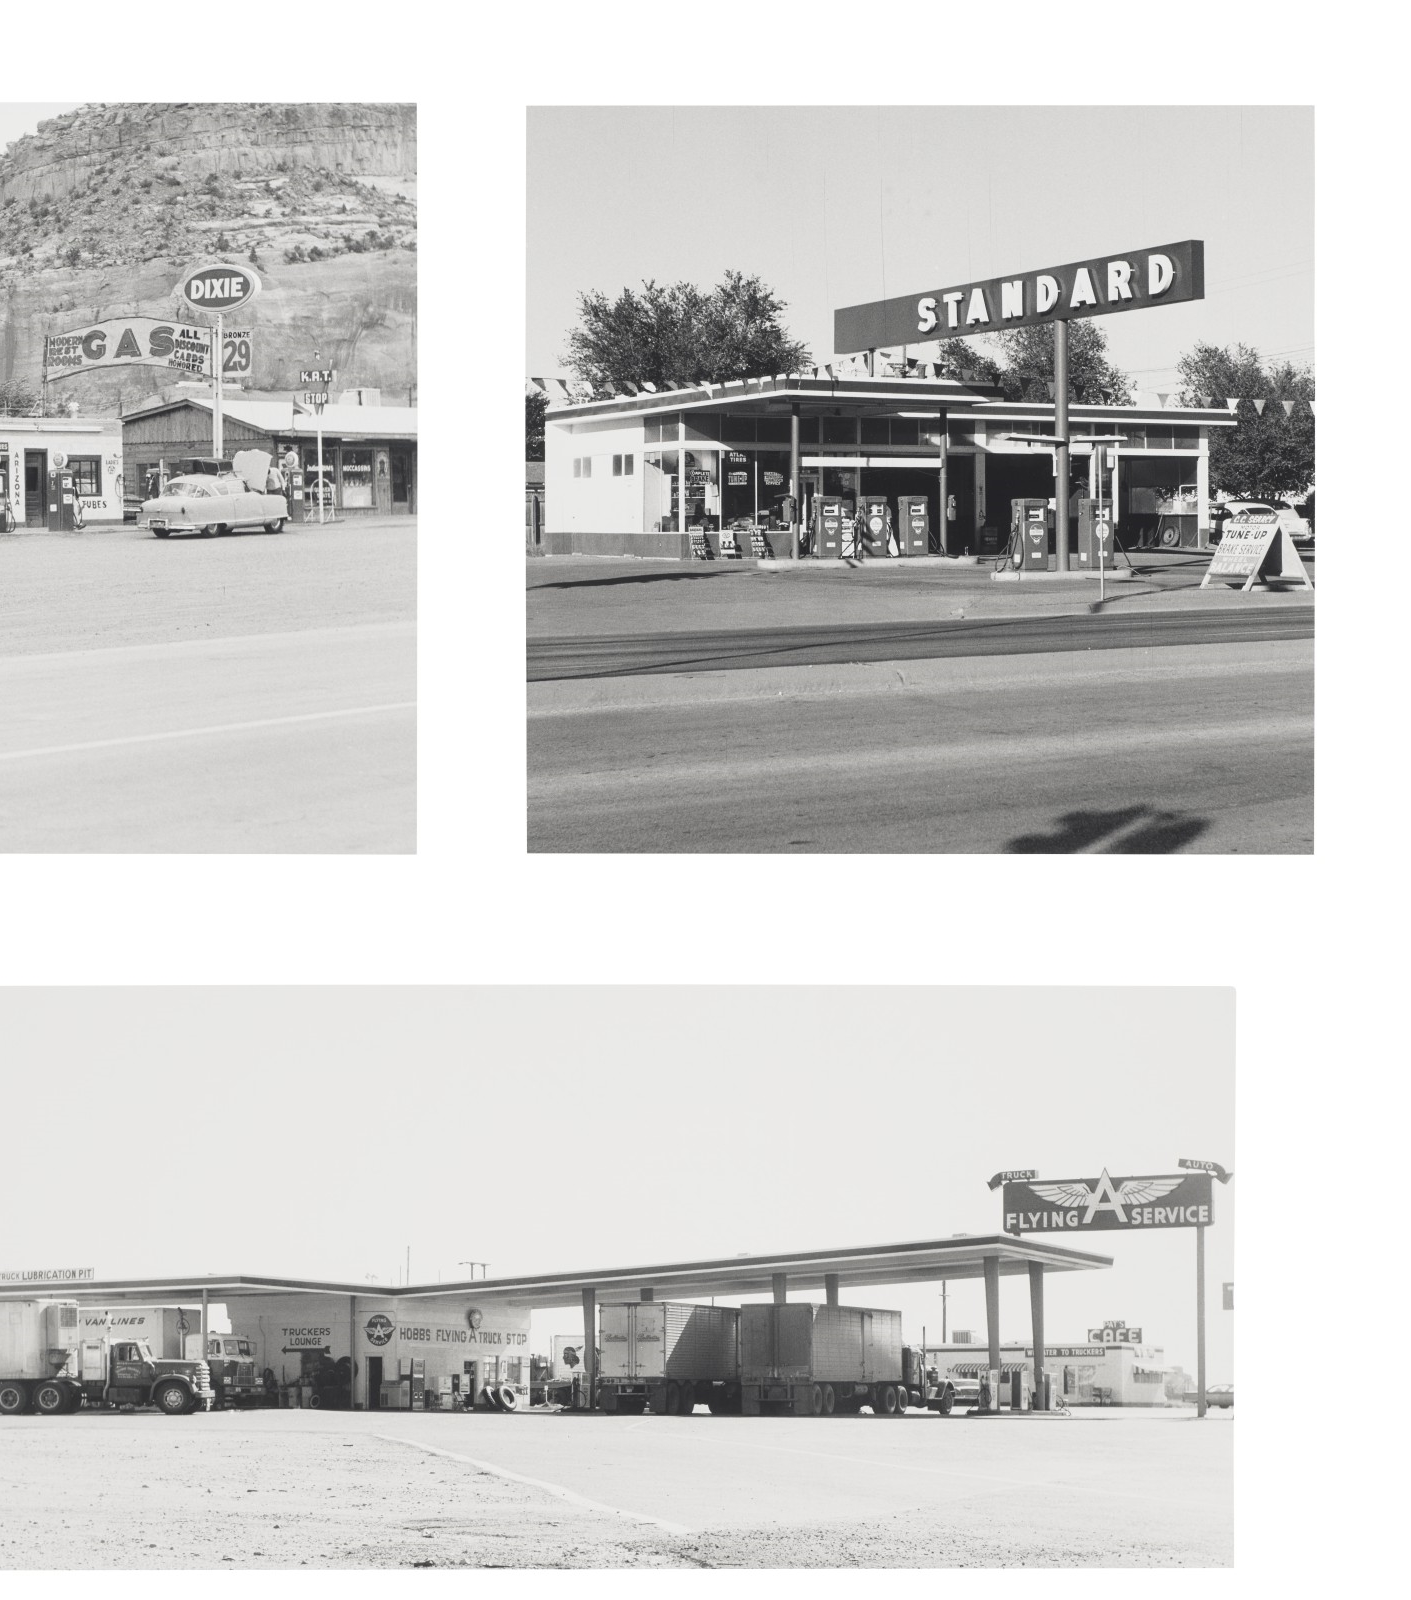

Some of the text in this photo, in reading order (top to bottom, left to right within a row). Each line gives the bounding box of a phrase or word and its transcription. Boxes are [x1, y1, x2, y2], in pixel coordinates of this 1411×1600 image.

[190, 276, 244, 300] DIXIE
[916, 253, 1177, 335] STANDARD
[179, 329, 201, 341] ALL
[223, 330, 251, 339] BRONZE
[48, 335, 84, 348] MODERN
[81, 325, 175, 360] GAS
[174, 338, 211, 355] DISCOUNT
[48, 346, 78, 356] REST
[173, 349, 205, 365] CARDS
[222, 339, 251, 373] 29
[47, 355, 83, 367] ROOMS
[167, 357, 203, 373] HONORED
[304, 392, 329, 404] STOP
[1225, 530, 1268, 540] TUNE-UP
[1217, 543, 1265, 555] BRAKE SERVICE
[1209, 561, 1256, 574] BALANCE
[1185, 1159, 1214, 1171] AUTO
[1001, 1170, 1033, 1180] TRUCK
[1006, 1167, 1209, 1229] FLYING A SERVICE
[21, 1269, 77, 1281] LUBRICATION
[77, 1269, 92, 1279] PIT
[85, 1316, 146, 1326] VAN LINES
[281, 1327, 331, 1336] TRUCKERS
[399, 1327, 527, 1345] HOBBS FLYING A TRUCK STOP
[1088, 1328, 1141, 1343] CAFE
[289, 1337, 322, 1346] LOUNGE
[370, 1336, 388, 1345] SERVICE
[1060, 1348, 1104, 1356] TO TRUCKERS
